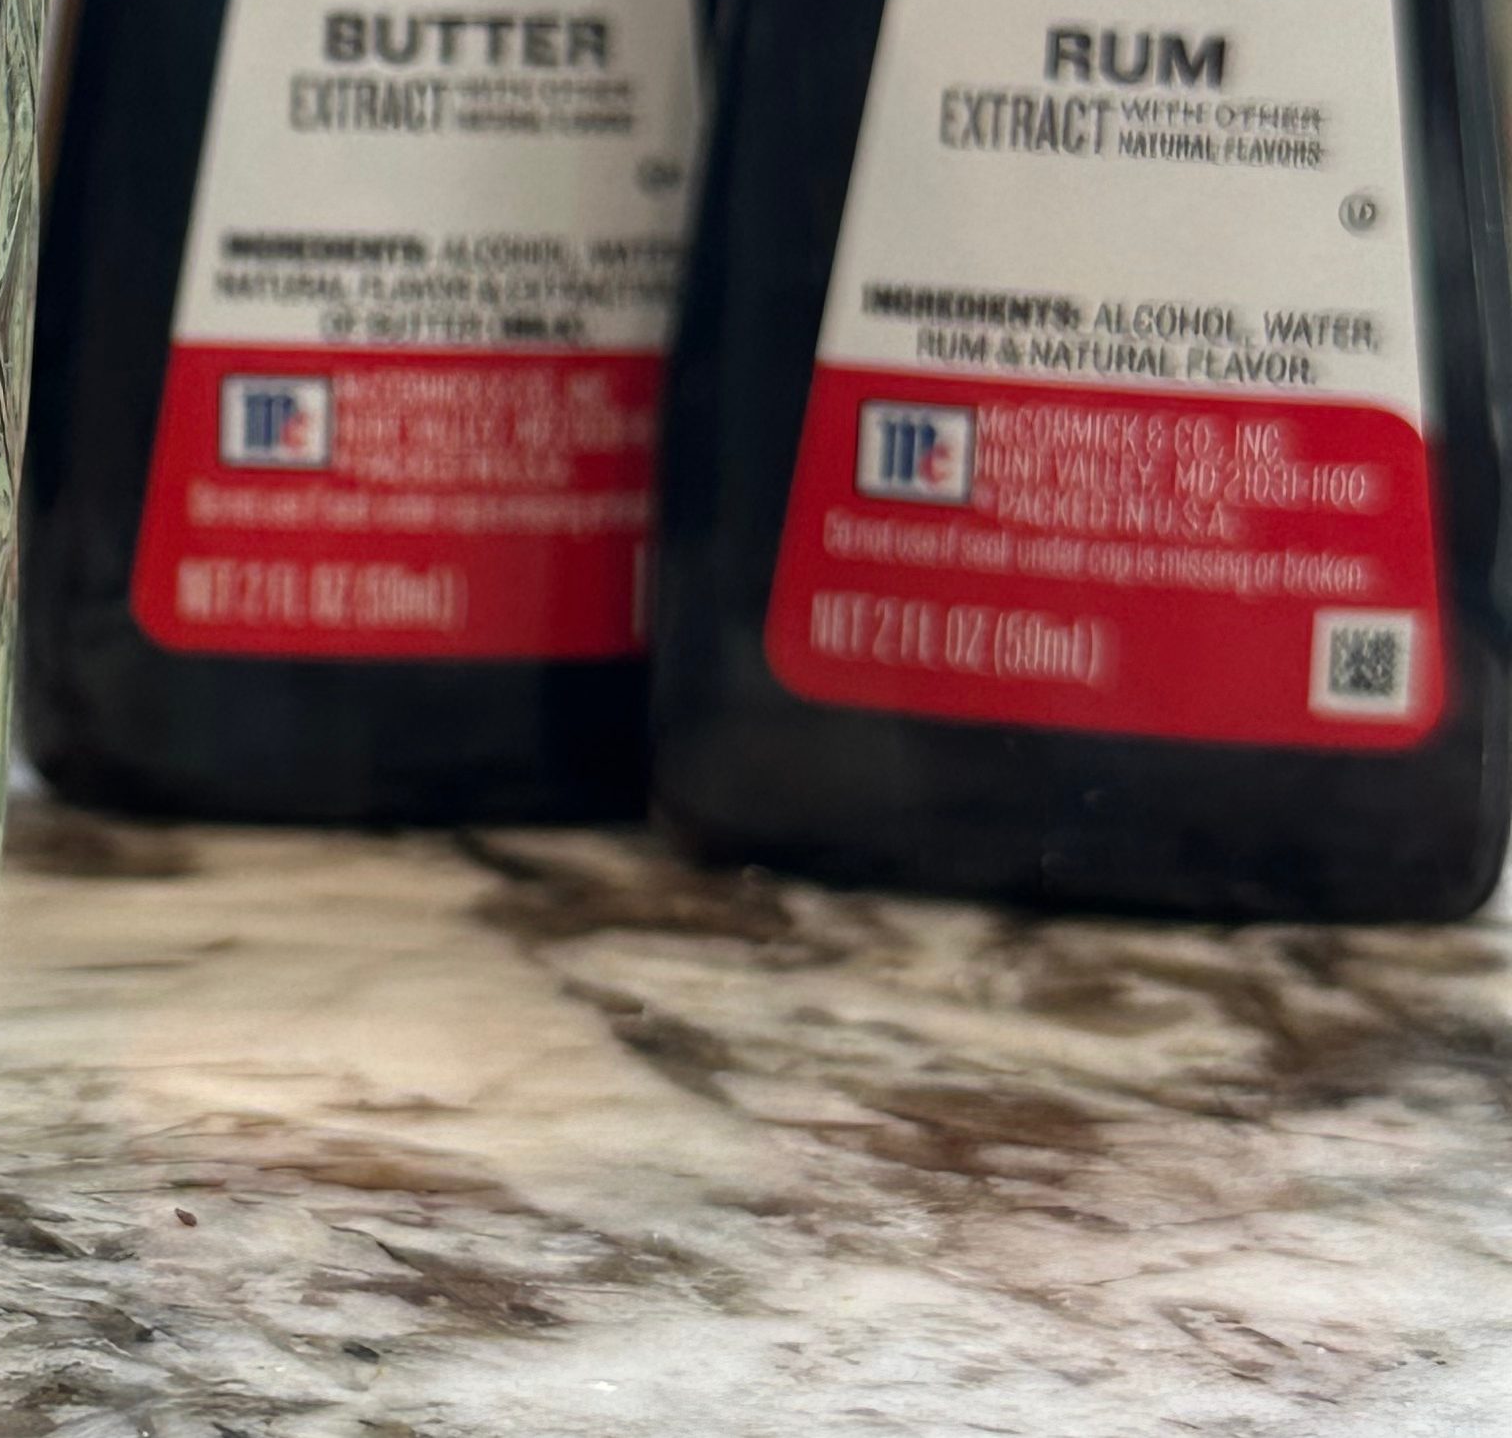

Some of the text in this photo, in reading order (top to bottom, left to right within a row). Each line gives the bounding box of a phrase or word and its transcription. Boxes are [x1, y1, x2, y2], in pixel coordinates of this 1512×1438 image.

[323, 11, 609, 68] BUTTER
[1042, 25, 1229, 91] RUM
[290, 74, 444, 135] EXTRACT
[939, 87, 1112, 156] EXTRACT
[1120, 98, 1321, 134] WITH OTHER
[1117, 129, 1322, 169] NATURAL FLAVORS
[916, 326, 1317, 386] RUM & NATURAL FLAVOR.
[1092, 300, 1252, 348] ALCOHOL,
[1263, 309, 1378, 354] WATER,
